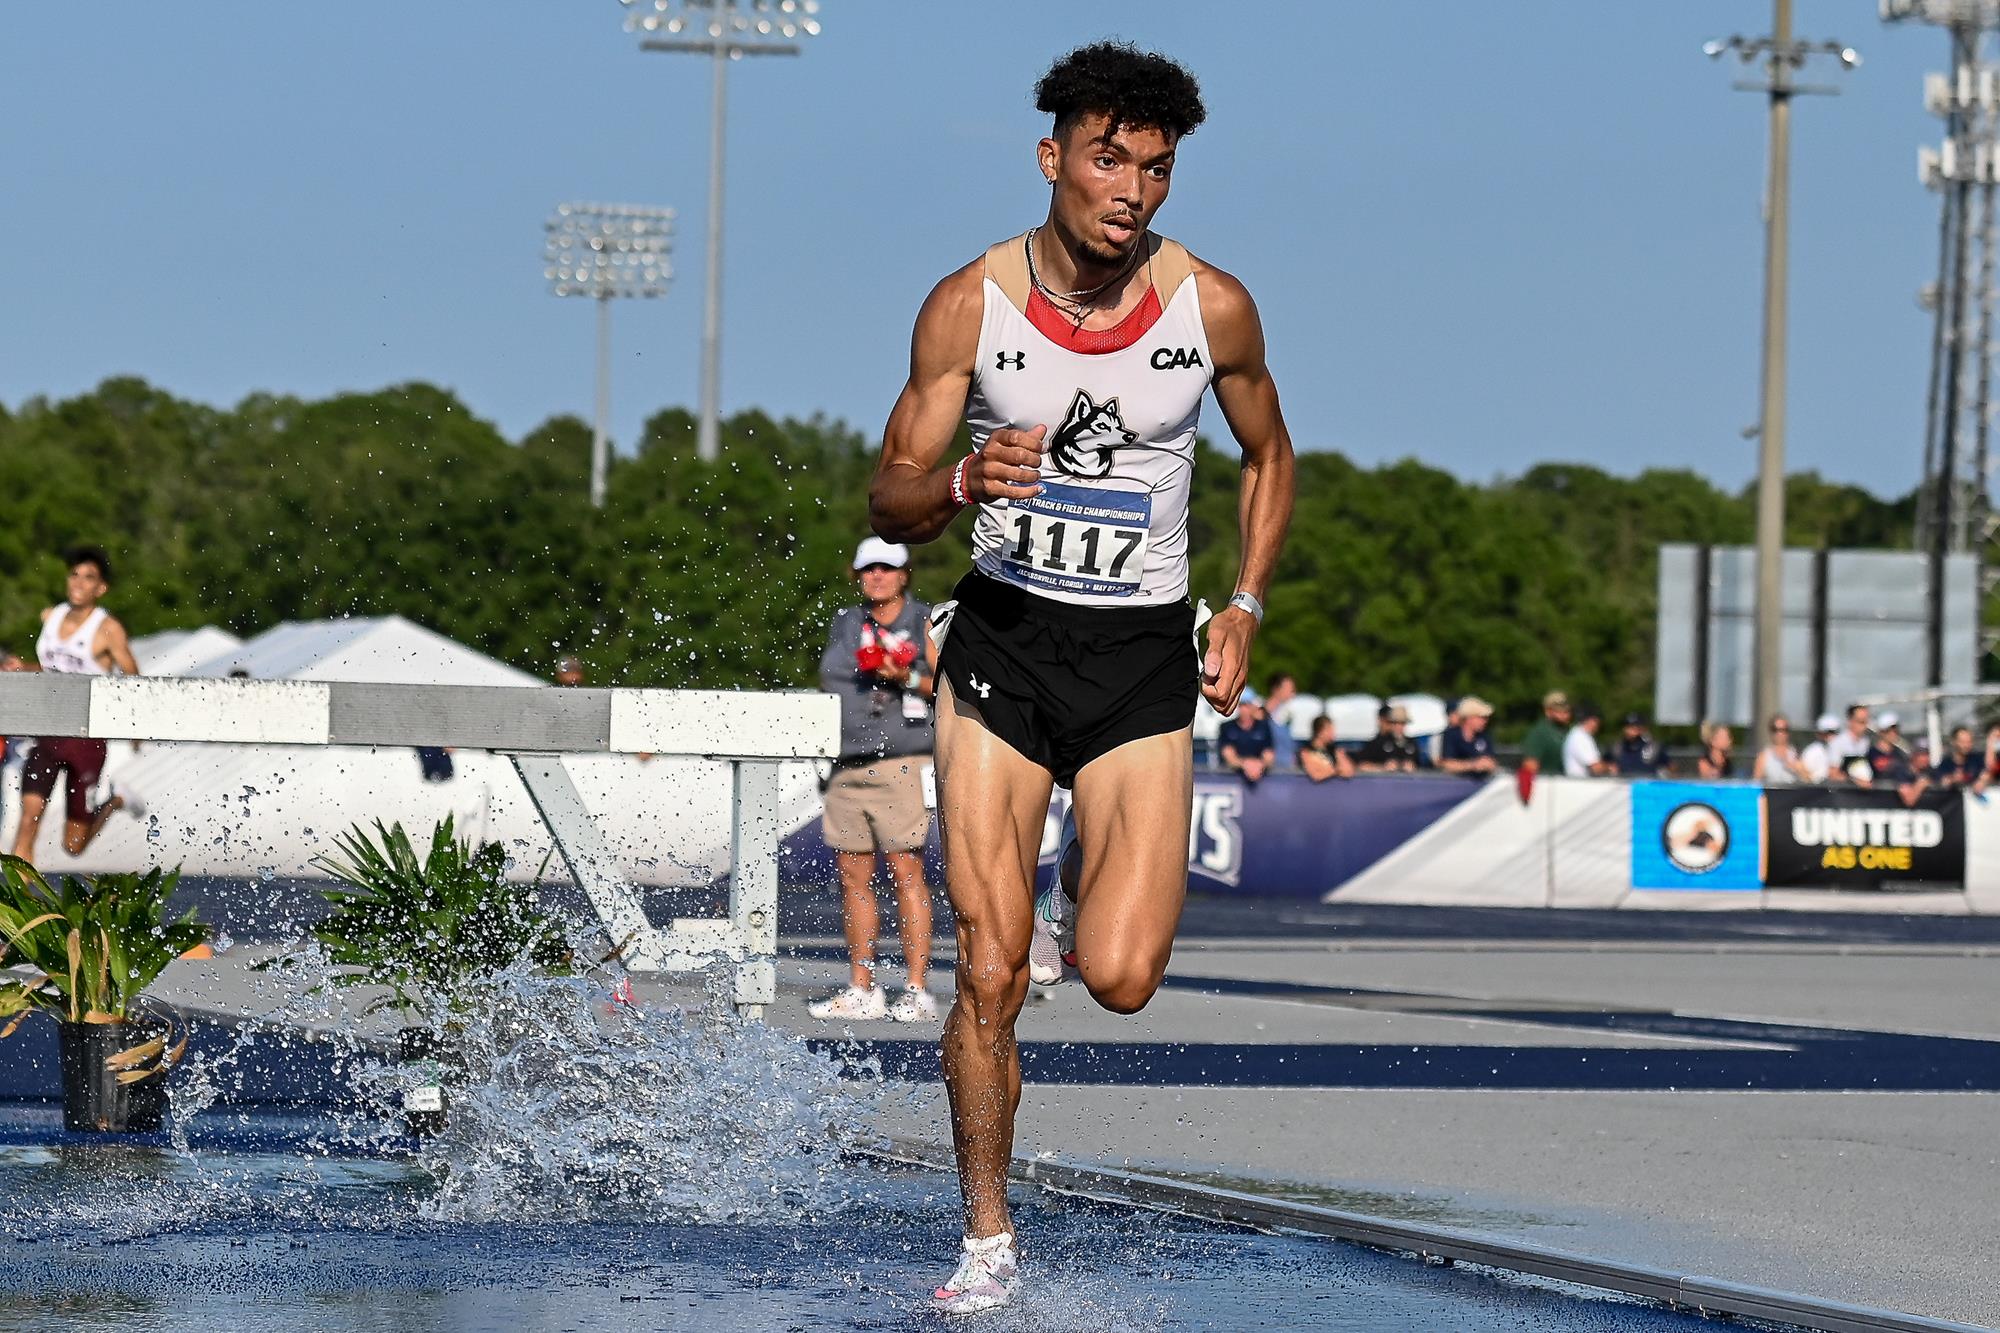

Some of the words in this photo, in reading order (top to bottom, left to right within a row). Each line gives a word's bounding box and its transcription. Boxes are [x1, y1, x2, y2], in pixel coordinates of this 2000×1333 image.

[1150, 347, 1204, 370] CAA
[1032, 498, 1056, 512] TRACK
[1062, 503, 1083, 515] FIELD
[1083, 506, 1146, 522] CHAMPIONSHIPS
[1010, 514, 1143, 578] 1117
[1058, 579, 1084, 589] FLORIDA
[1092, 583, 1107, 592] MAY
[1791, 806, 1944, 848] UNITED
[1822, 846, 1857, 869] AS
[1859, 846, 1913, 870] ONE
